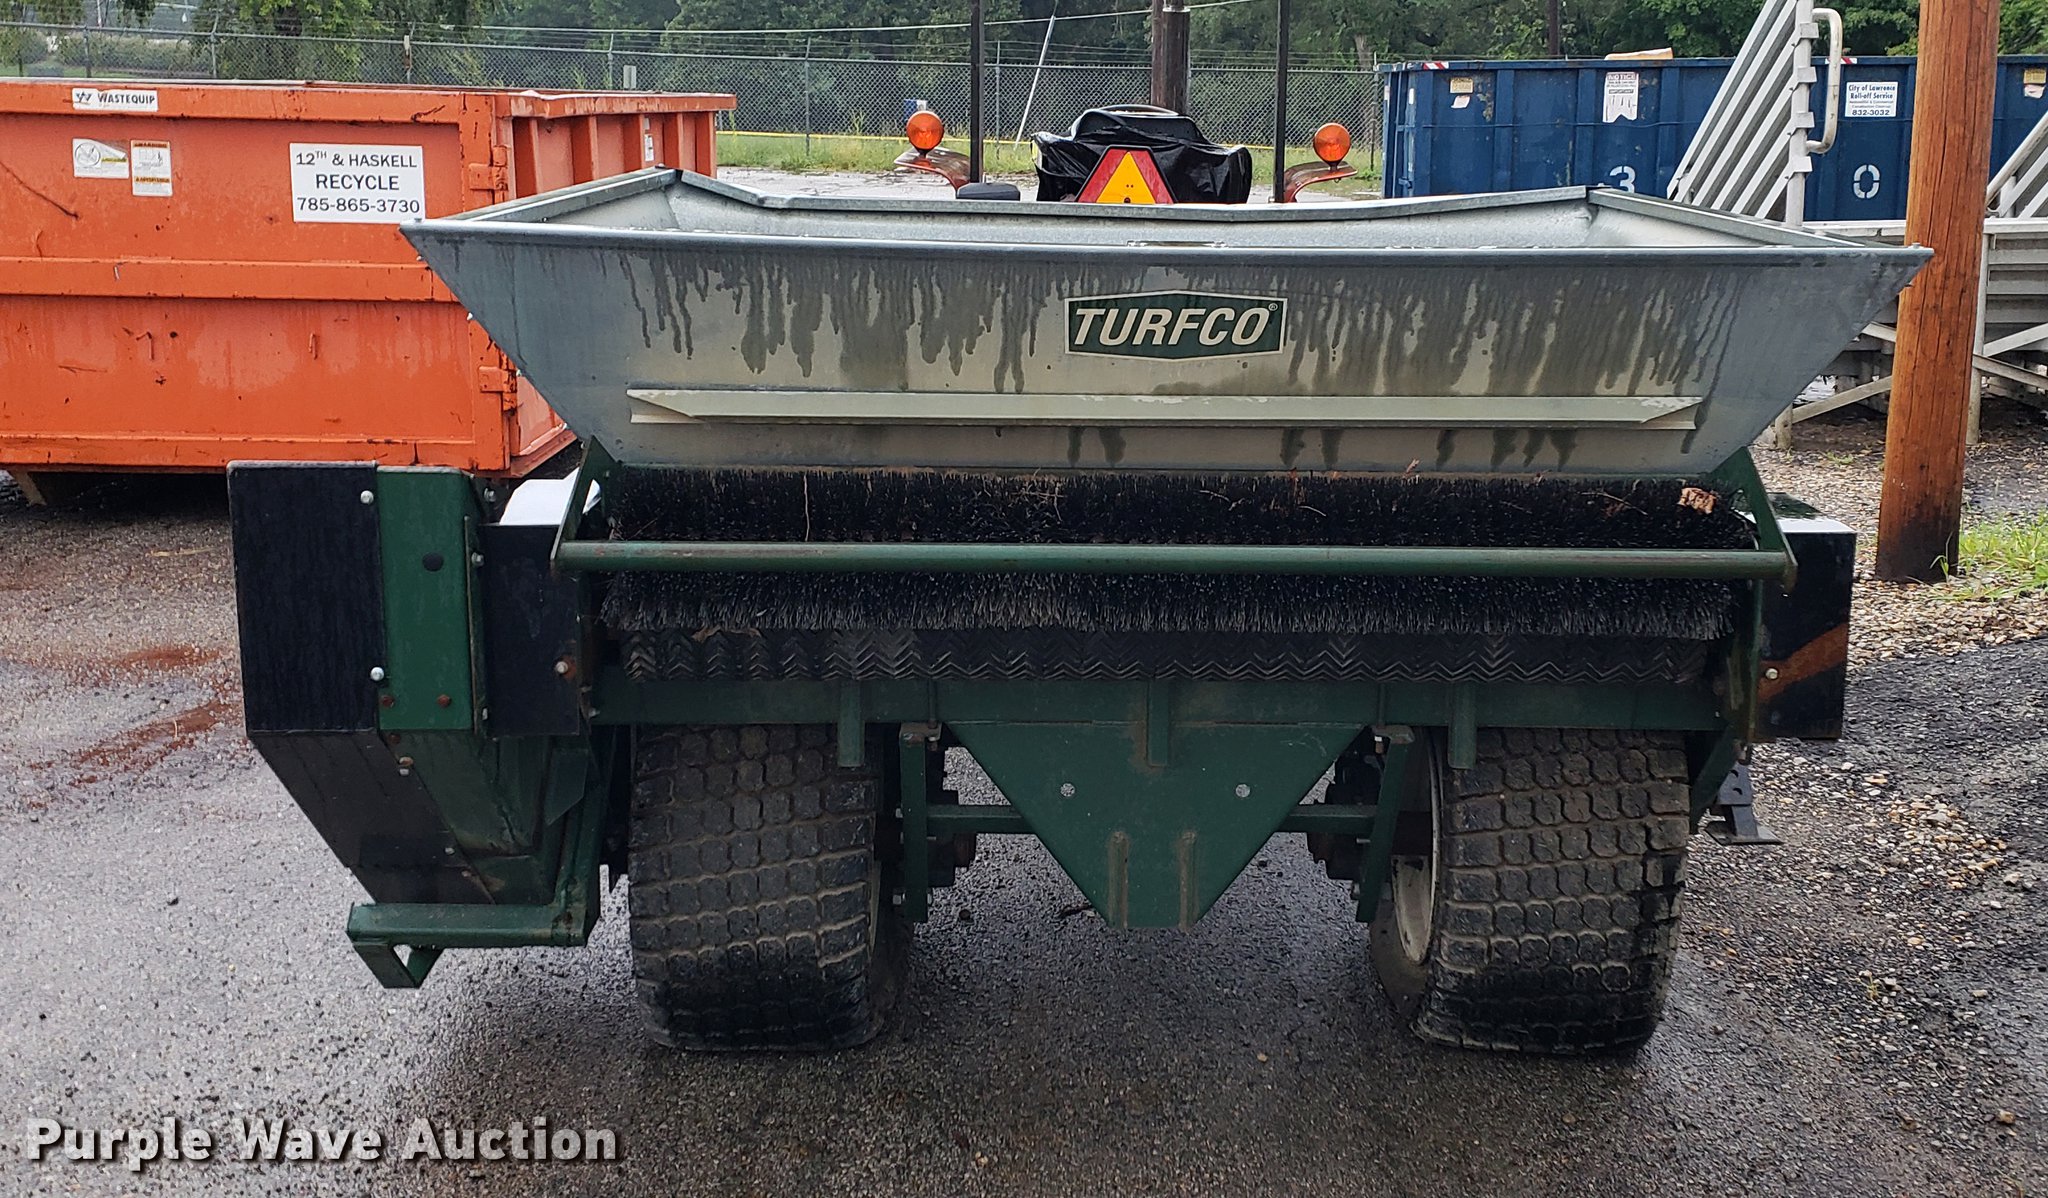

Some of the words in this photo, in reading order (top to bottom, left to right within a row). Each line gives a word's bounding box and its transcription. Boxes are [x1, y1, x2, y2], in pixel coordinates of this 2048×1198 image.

[1848, 84, 1860, 92] City
[97, 92, 155, 104] WASTEQUIP
[332, 153, 345, 166] &
[349, 154, 418, 168] HASKELL
[315, 174, 400, 191] RECYCLE
[297, 197, 420, 213] 785-865-3730
